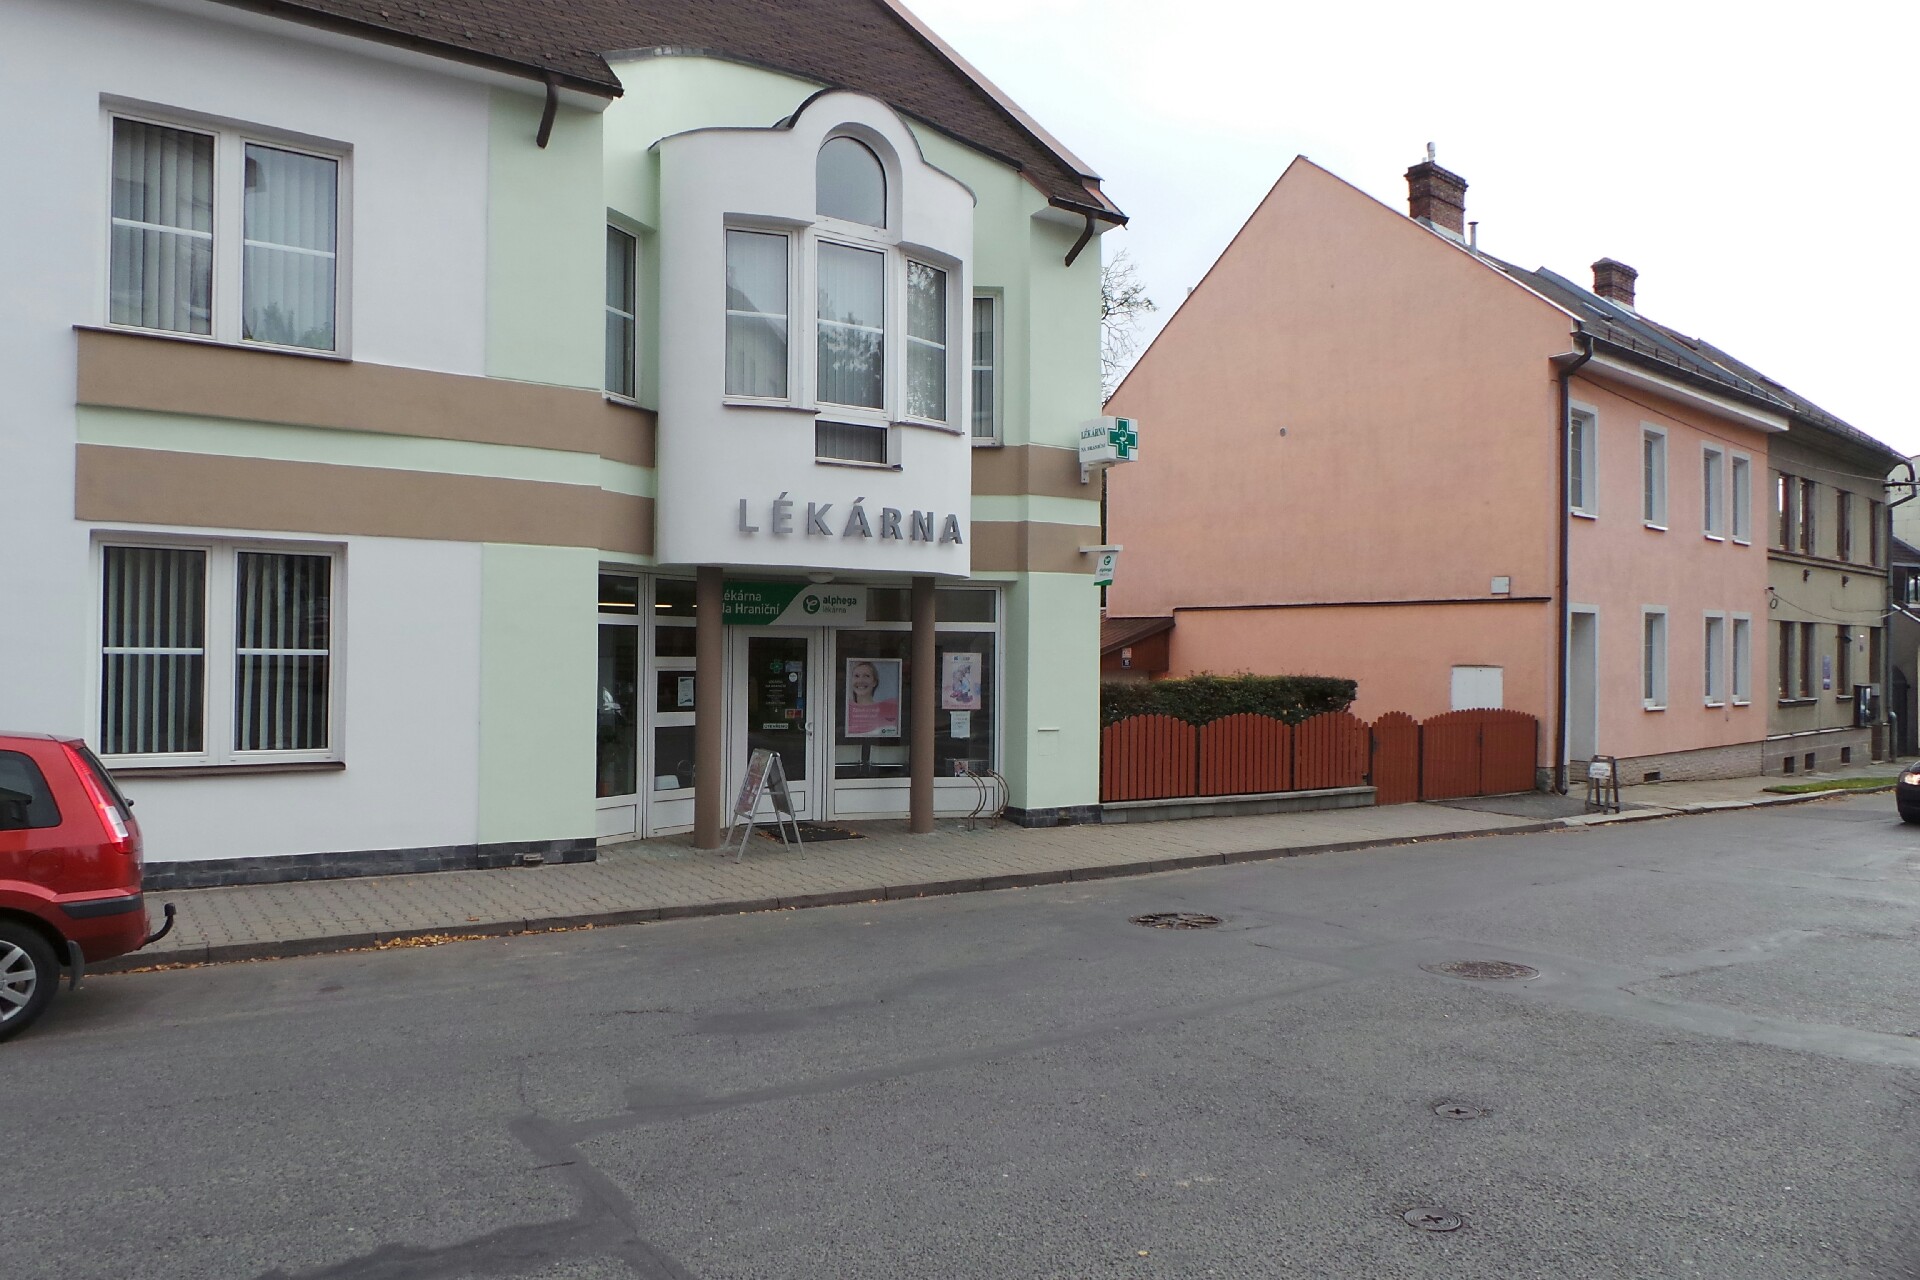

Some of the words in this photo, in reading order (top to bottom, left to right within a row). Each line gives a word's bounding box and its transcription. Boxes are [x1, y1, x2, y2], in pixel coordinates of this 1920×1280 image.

[1081, 427, 1106, 440] LÉKÁRNA
[738, 491, 964, 545] LÉKÁRNA
[722, 589, 762, 601] ékárna
[822, 595, 858, 606] alphega
[735, 602, 780, 615] Hraniční
